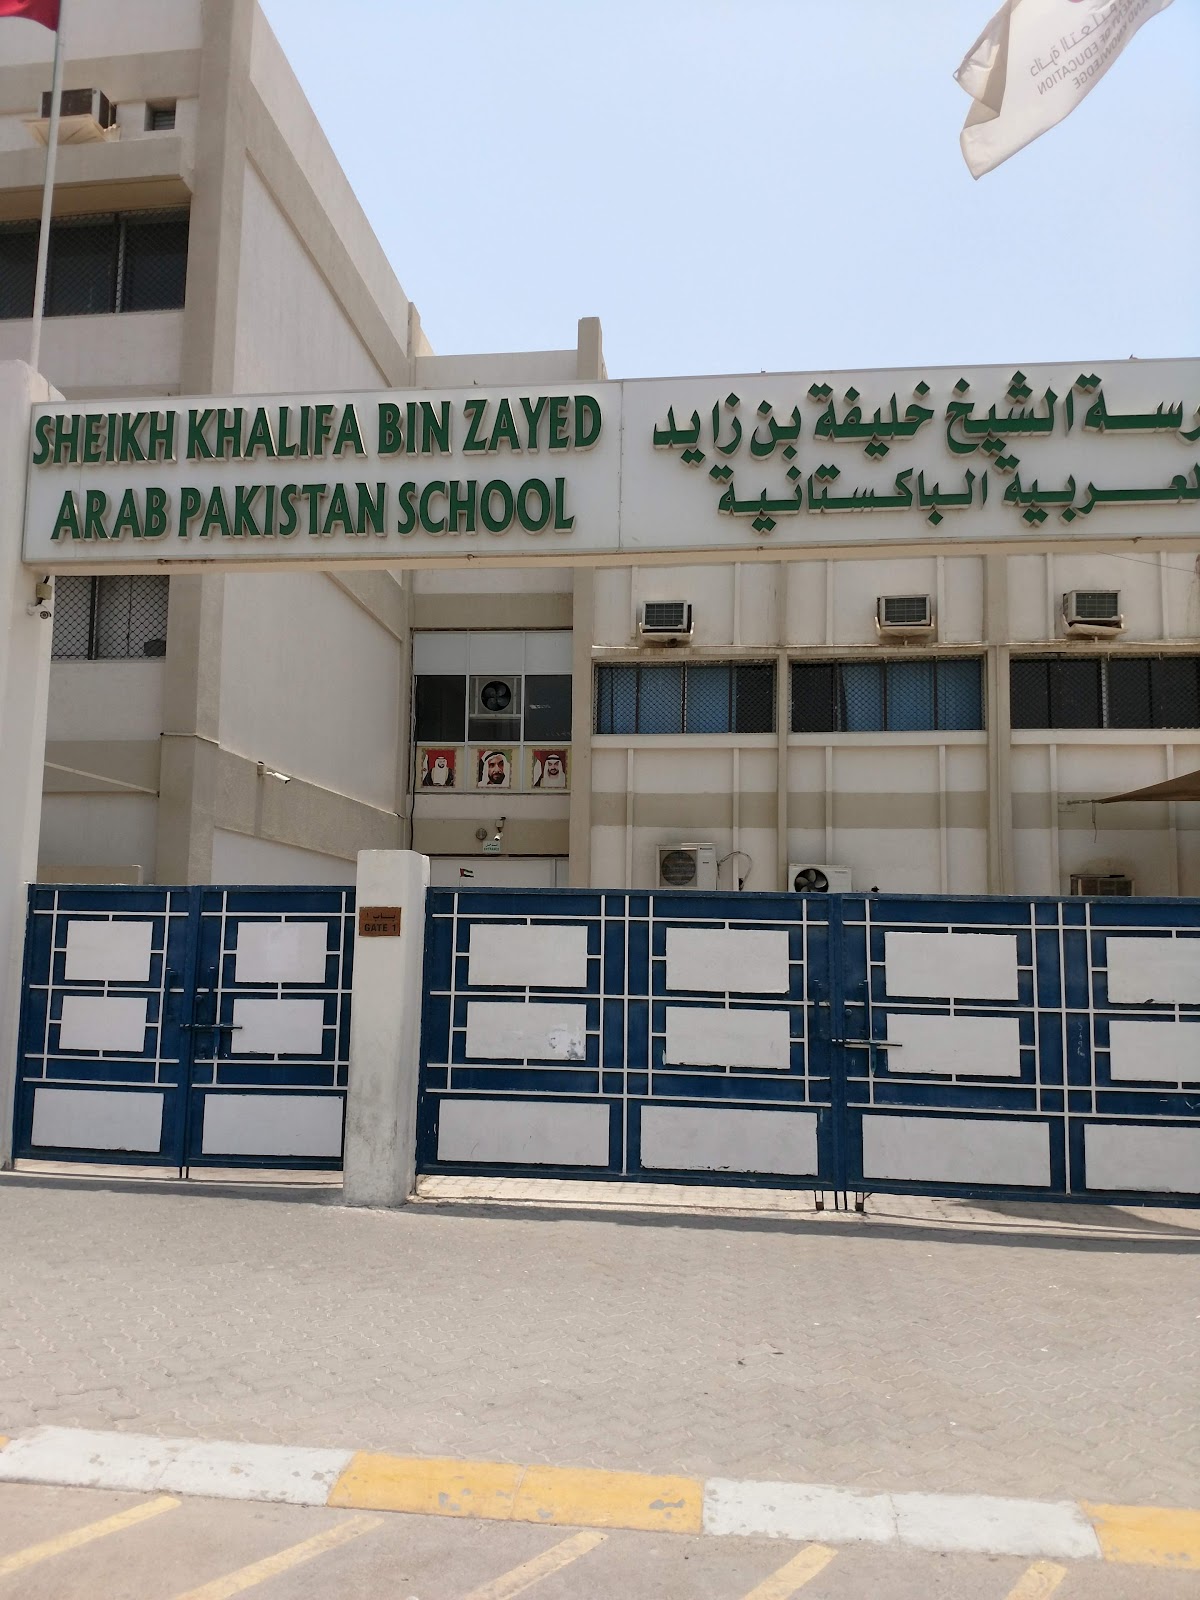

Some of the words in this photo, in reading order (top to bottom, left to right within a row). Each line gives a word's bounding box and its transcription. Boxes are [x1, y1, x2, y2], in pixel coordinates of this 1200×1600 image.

[33, 410, 177, 465] SHEIKH
[186, 404, 367, 460] KHALIFA
[378, 401, 452, 456] BIN
[462, 395, 603, 453] ZAYED
[653, 392, 741, 466] زايد
[751, 400, 802, 460] بن
[807, 381, 935, 460] خليفة
[945, 370, 1073, 457] الشيخ
[50, 487, 169, 541] ARAB
[178, 482, 388, 539] PAKISTAN
[398, 478, 576, 536] SCHOOL
[709, 464, 988, 533] الباكستانية
[364, 923, 388, 932] GATE
[392, 924, 396, 932] 1
